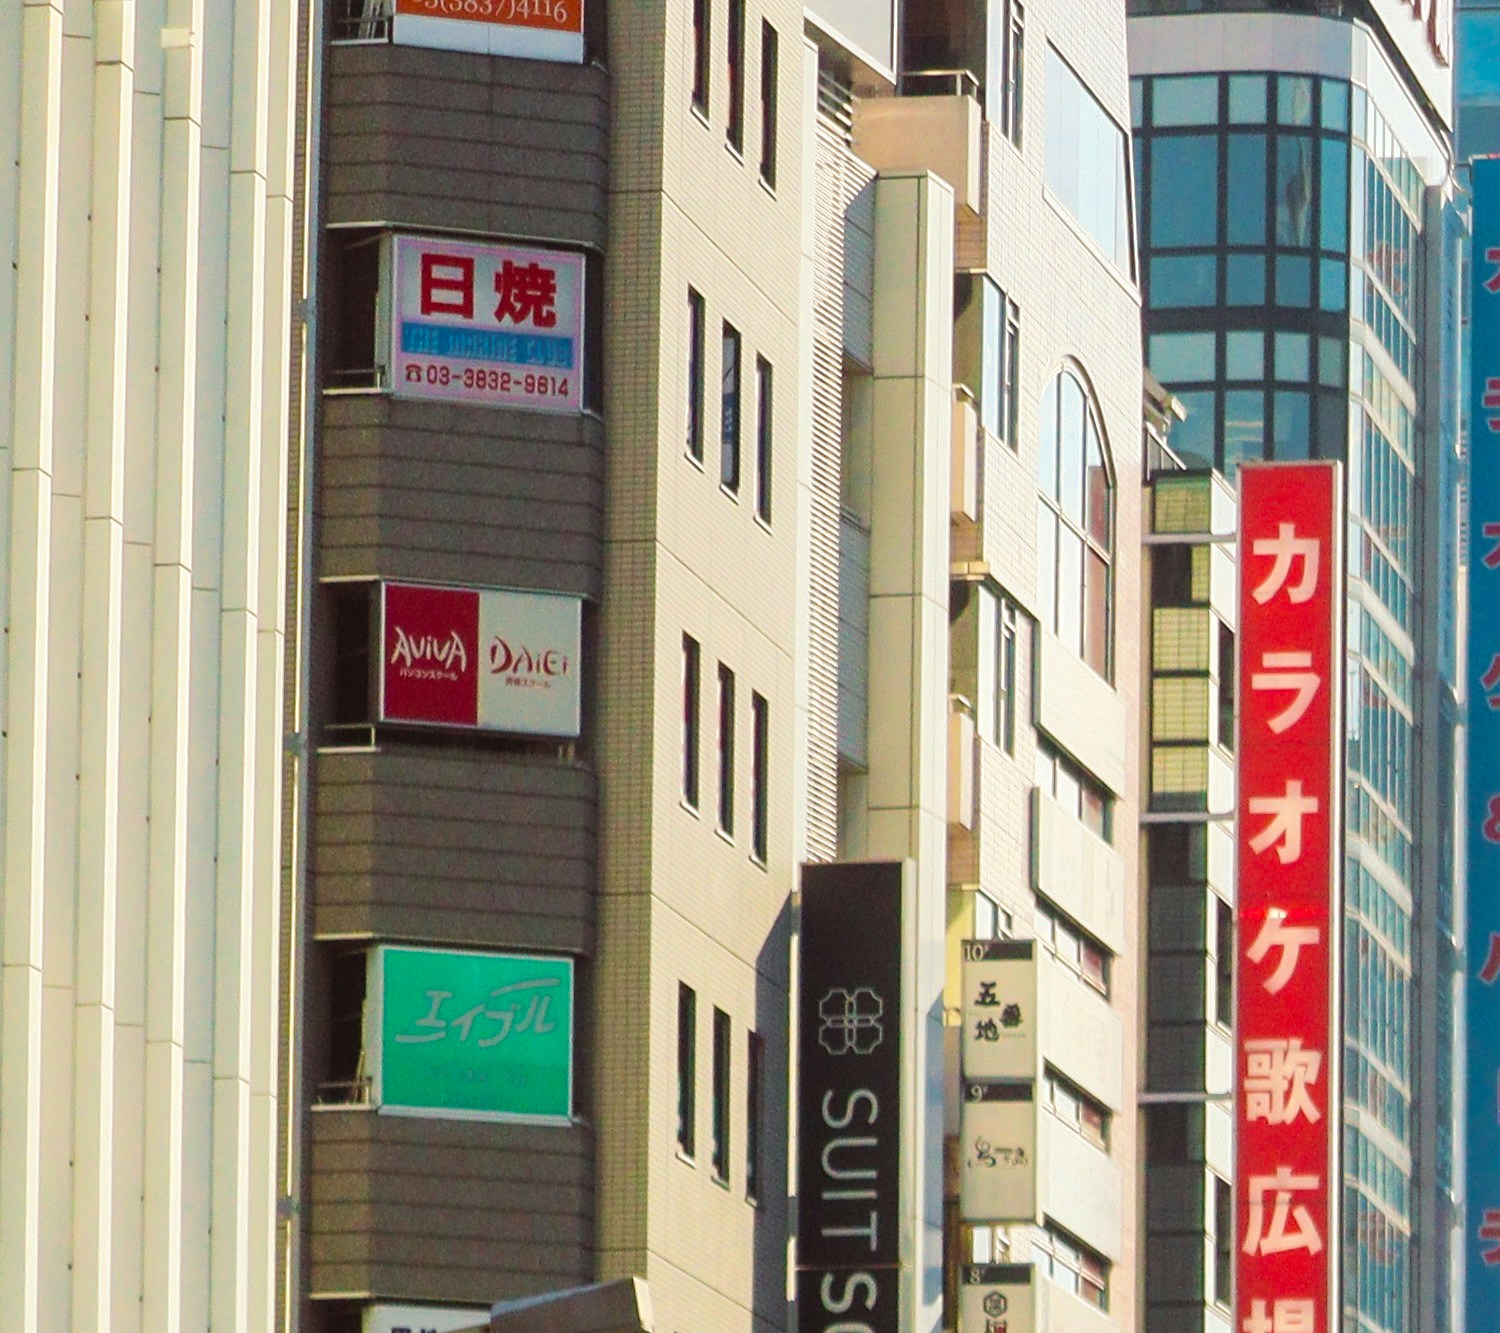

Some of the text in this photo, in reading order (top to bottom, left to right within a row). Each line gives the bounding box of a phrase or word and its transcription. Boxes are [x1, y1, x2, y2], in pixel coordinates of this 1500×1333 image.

[419, 253, 558, 328] 日焼
[395, 977, 561, 1047] エイブル
[820, 1088, 877, 1251] SUIT
